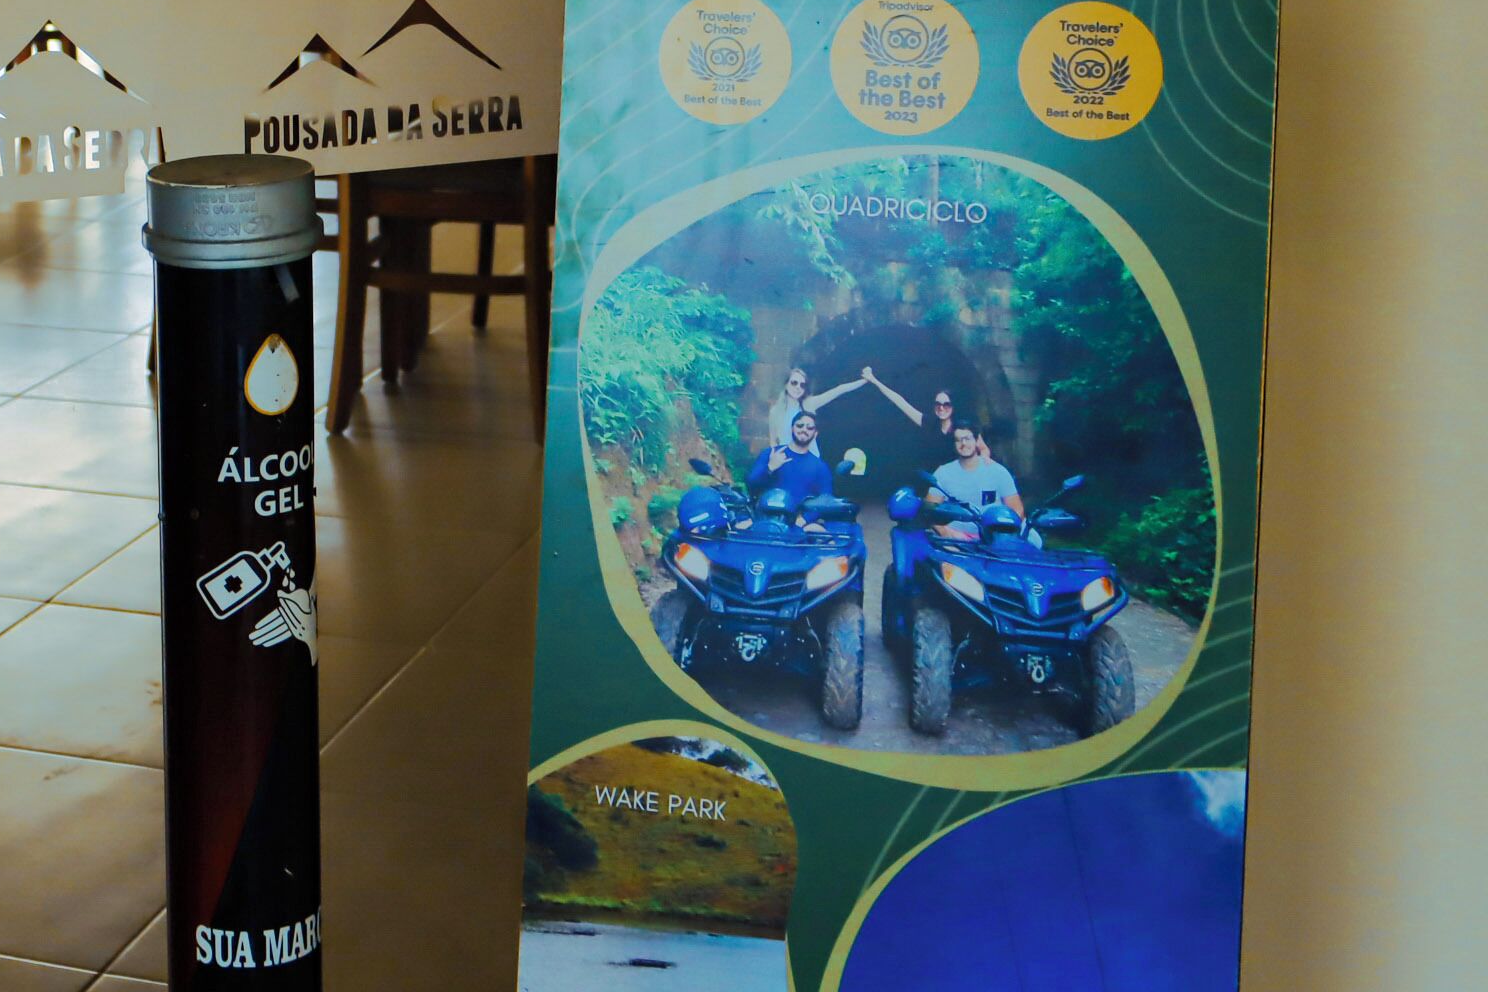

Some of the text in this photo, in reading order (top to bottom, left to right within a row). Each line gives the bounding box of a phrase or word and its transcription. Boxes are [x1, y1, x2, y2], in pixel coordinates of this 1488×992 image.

[878, 0, 935, 12] Tripadvisor
[864, 69, 942, 91] Best of
[683, 94, 763, 107] Best of the Best
[858, 89, 947, 110] the Best
[1072, 94, 1105, 106] 2022
[244, 94, 524, 155] POUSADA DA SERRA
[883, 110, 919, 125] 2023
[1045, 107, 1130, 122] Best of the Best
[14, 134, 55, 176] DA
[809, 192, 988, 225] QUADRICICLO
[217, 441, 314, 483] ÁLCOO
[254, 484, 305, 517] GEL
[595, 784, 728, 822] WAKE PARK
[195, 905, 321, 968] SUA MAR
